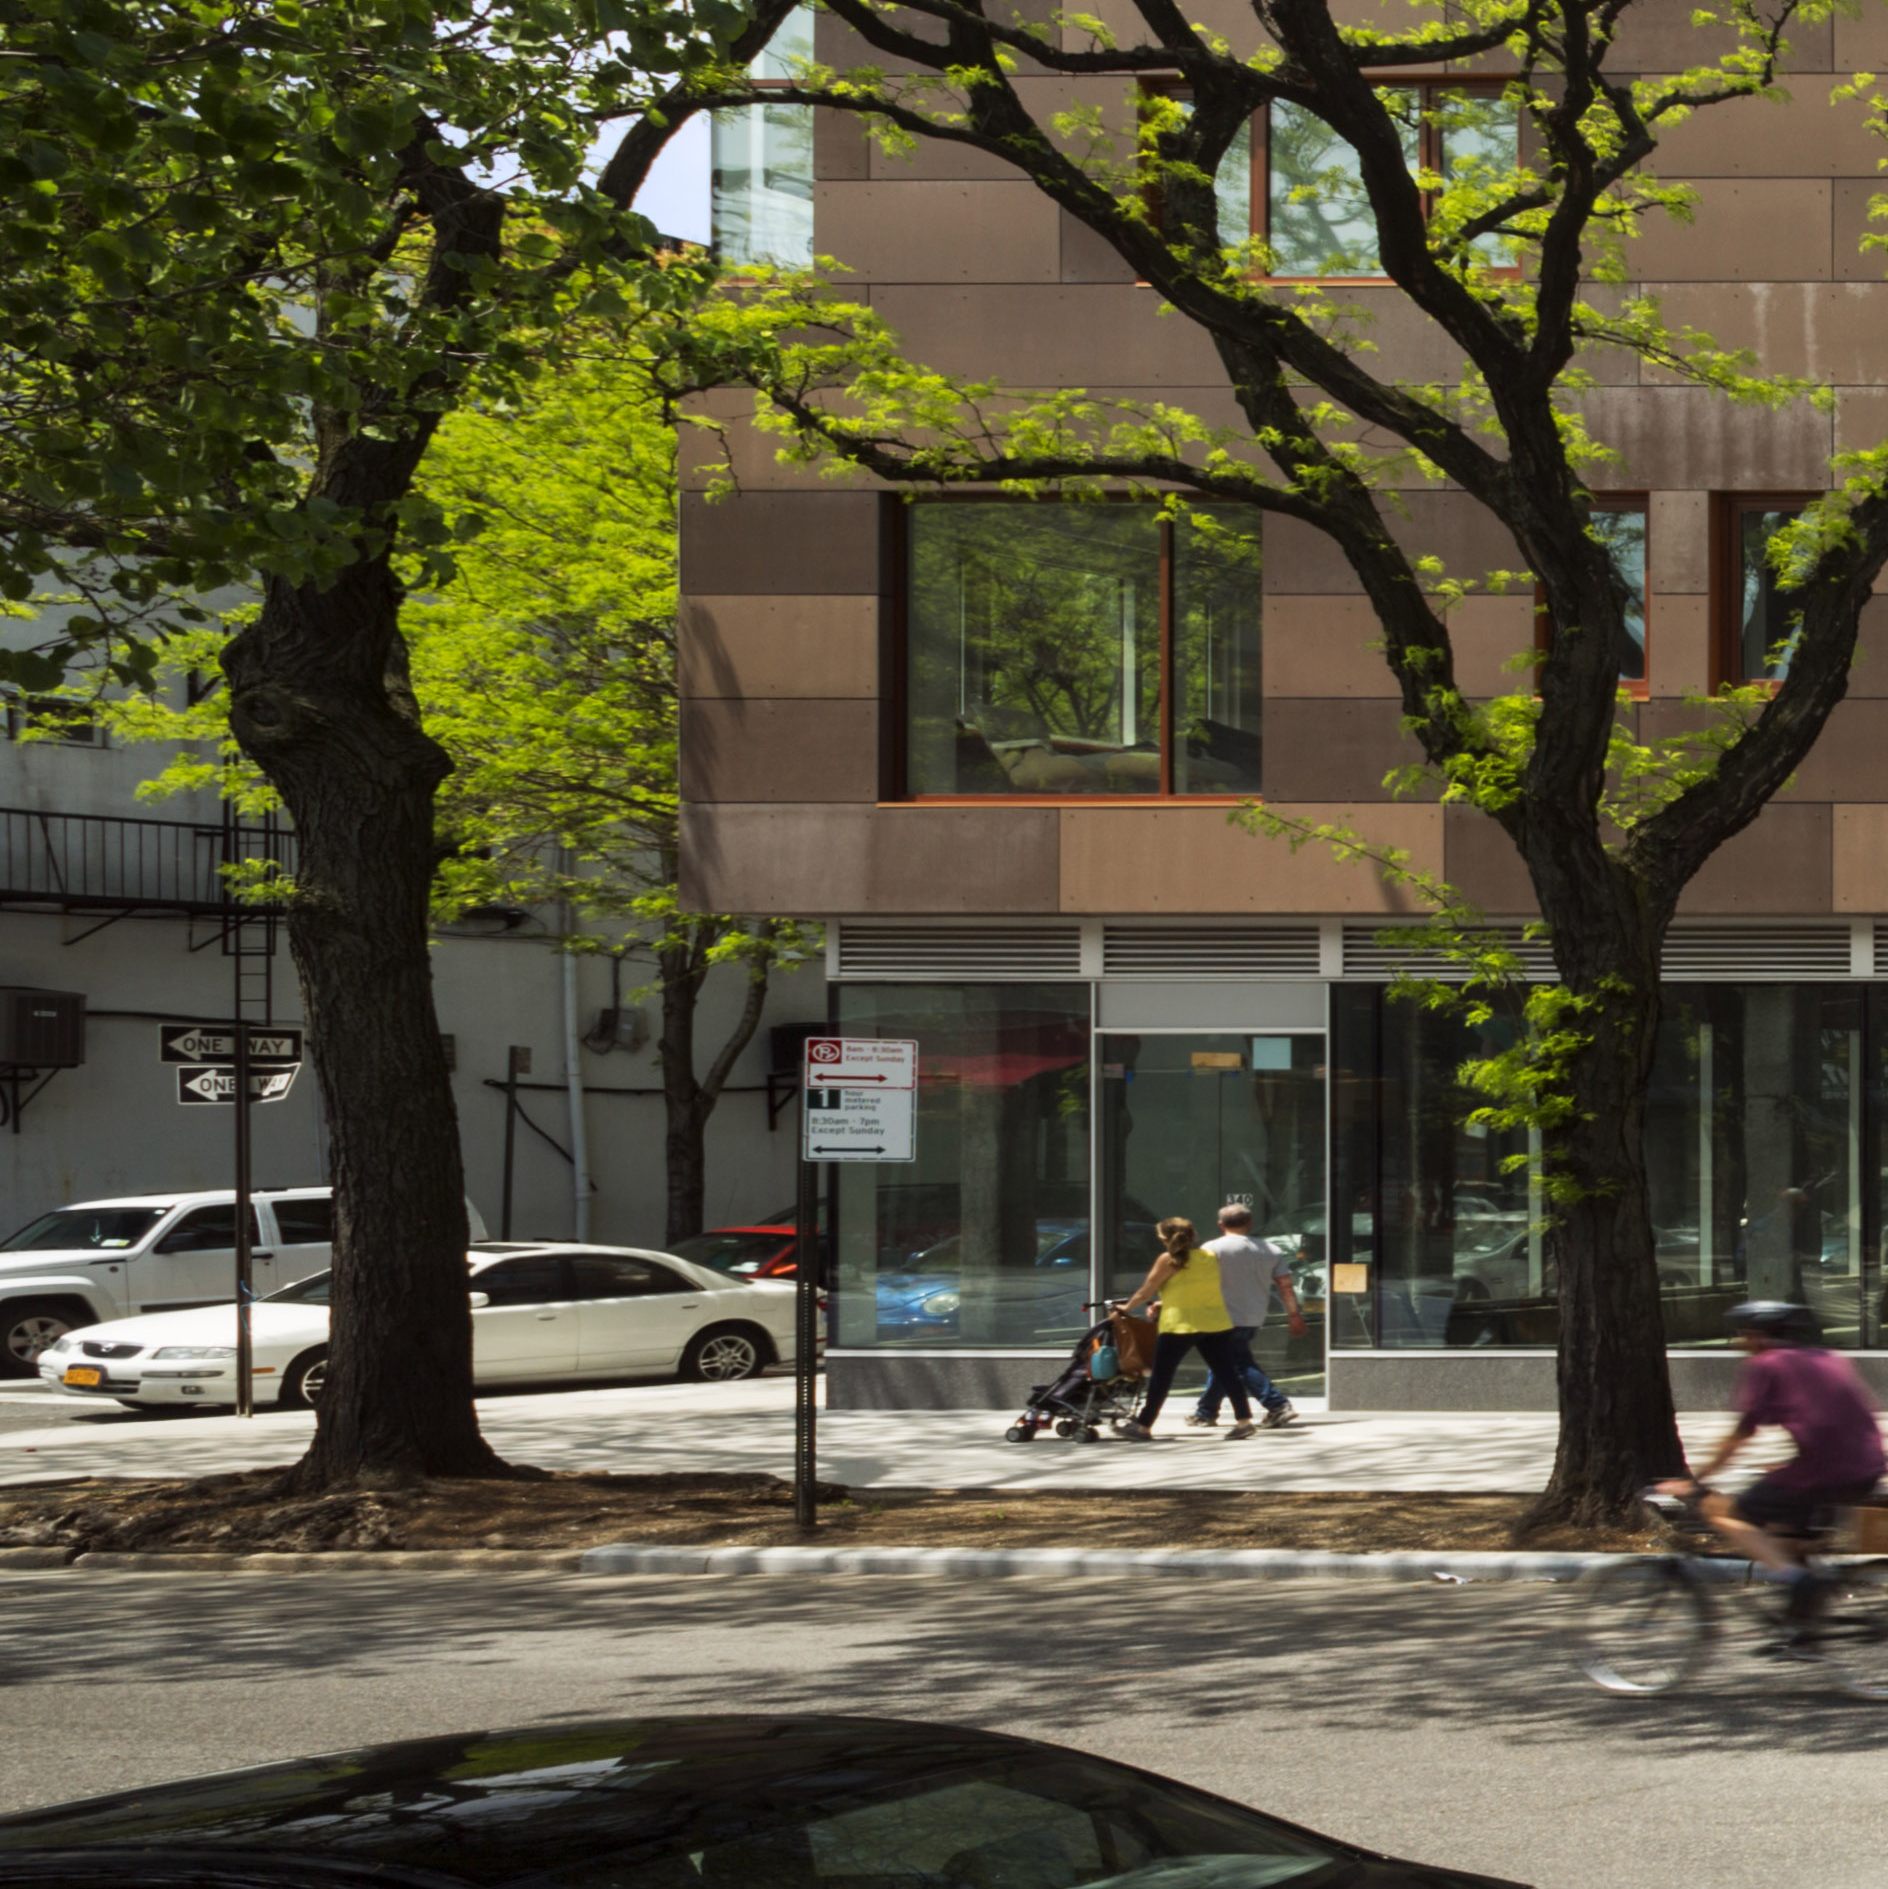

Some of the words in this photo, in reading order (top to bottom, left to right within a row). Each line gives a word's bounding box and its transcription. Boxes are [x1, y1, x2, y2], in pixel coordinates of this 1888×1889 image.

[183, 1037, 223, 1052] ONE
[200, 1077, 236, 1092] ONE
[818, 1088, 829, 1108] 1
[811, 1117, 849, 1125] 8:30am
[860, 1117, 880, 1126] 7pm
[812, 1126, 846, 1134] Except
[849, 1126, 885, 1135] Sunday
